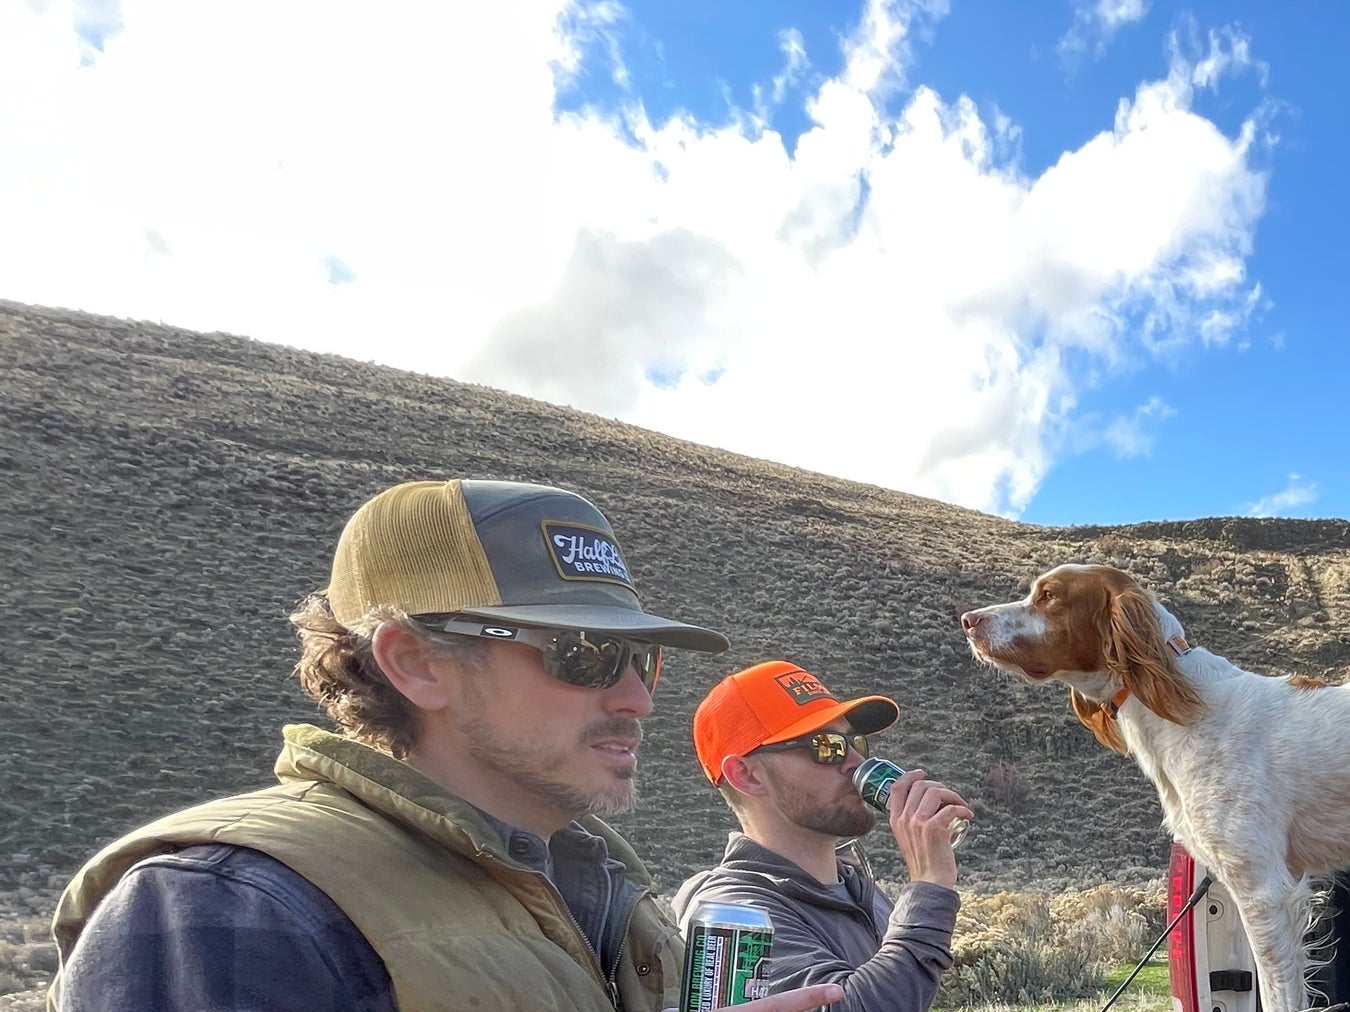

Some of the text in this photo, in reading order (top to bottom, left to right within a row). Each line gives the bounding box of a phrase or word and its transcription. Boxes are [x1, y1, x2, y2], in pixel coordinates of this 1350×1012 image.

[706, 935, 716, 950] BEER
[705, 952, 715, 966] REAL
[691, 950, 705, 988] BREWING
[704, 967, 713, 975] OF
[702, 976, 713, 1000] LUXURY
[689, 992, 701, 1012] LION
